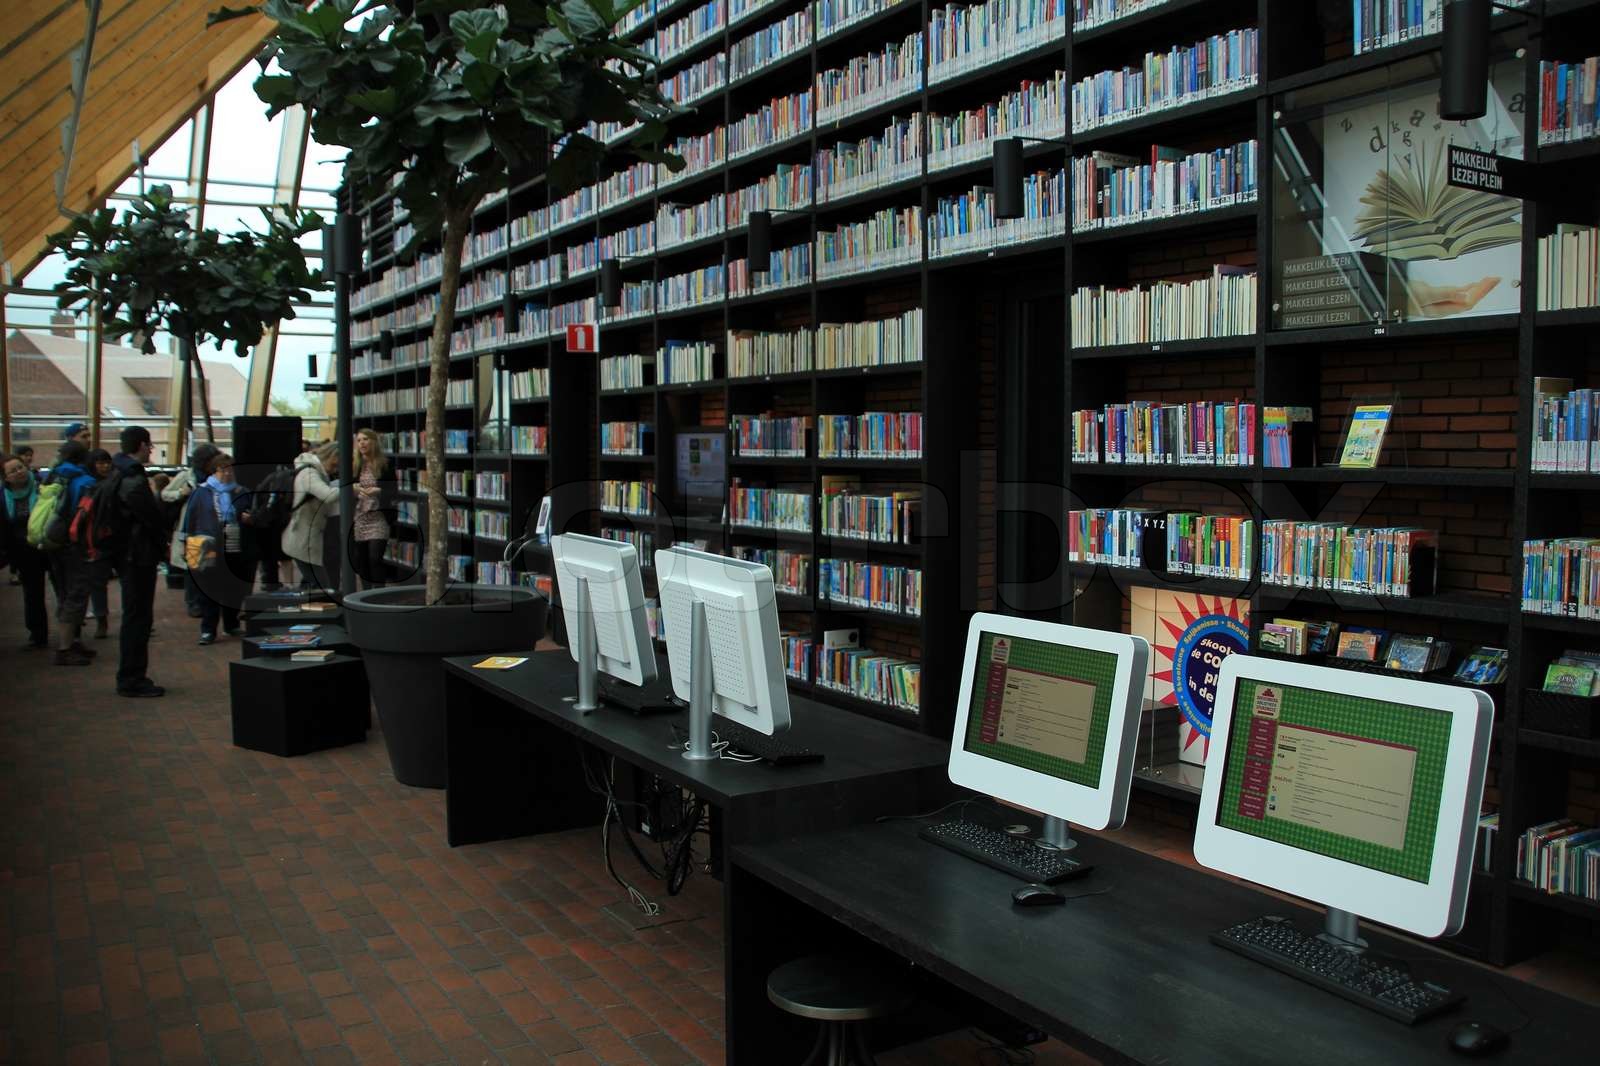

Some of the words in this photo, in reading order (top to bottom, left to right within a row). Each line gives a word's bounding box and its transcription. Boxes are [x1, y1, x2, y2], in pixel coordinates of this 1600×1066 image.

[1369, 126, 1387, 153] d
[1451, 150, 1498, 172] MAKKELIJK
[1452, 169, 1478, 185] LEZEN
[1480, 174, 1503, 190] PLEIN
[1285, 260, 1325, 274] MAKKELIJK
[1326, 256, 1352, 268] LEZEN
[1285, 278, 1325, 292] MAKKELIJK
[1285, 296, 1325, 310] MAKKELIJK
[1326, 293, 1351, 305] LEZEN
[1285, 314, 1325, 326] MAKKELIJK
[1326, 311, 1351, 323] LEZEN
[1144, 517, 1150, 528] X
[1152, 519, 1158, 529] Y
[1159, 519, 1165, 529] Z
[1190, 648, 1202, 660] de
[1188, 676, 1197, 691] in
[1199, 687, 1214, 703] de
